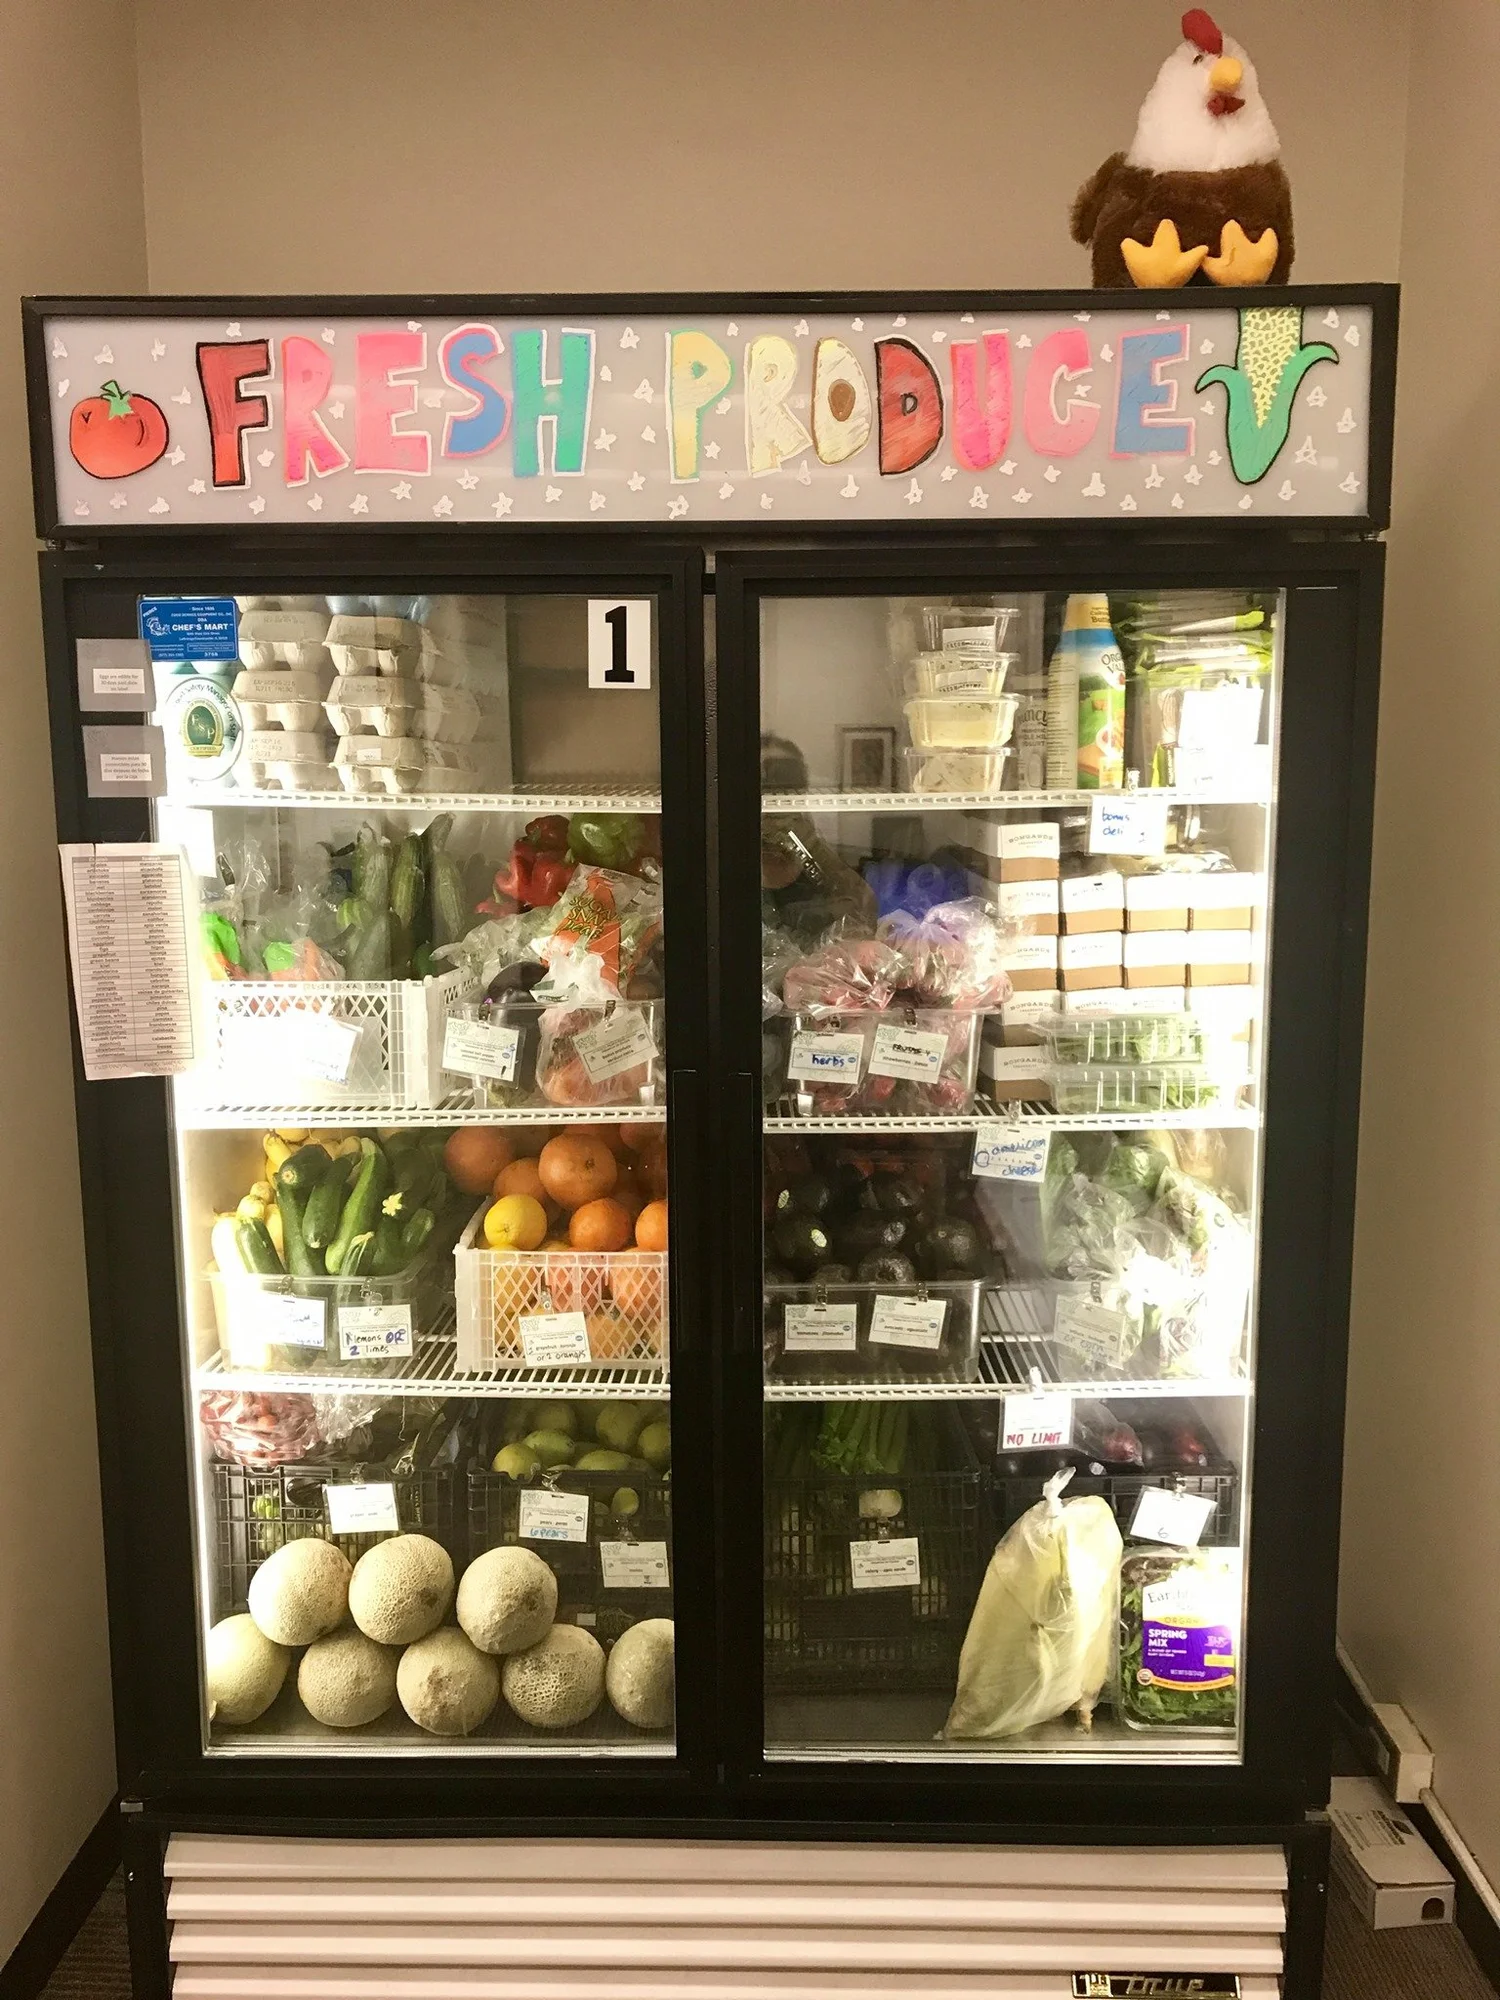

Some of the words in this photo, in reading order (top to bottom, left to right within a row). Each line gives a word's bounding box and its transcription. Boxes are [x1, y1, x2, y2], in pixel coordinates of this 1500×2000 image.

[196, 323, 596, 489] FRESH
[665, 324, 1196, 484] PRODUCE
[171, 623, 201, 631] CHEF'S
[605, 606, 634, 682] 1
[1103, 826, 1124, 836] deli
[812, 1054, 845, 1067] herbs
[354, 1335, 382, 1343] lemons
[386, 1328, 406, 1344] OR
[350, 1345, 360, 1356] 2
[366, 1345, 390, 1354] limes
[1006, 1433, 1024, 1446] NO
[1031, 1431, 1063, 1445] LIMIT
[540, 1529, 569, 1539] pears
[1157, 1526, 1169, 1540] 6
[1148, 1628, 1188, 1640] SPRING
[1148, 1638, 1169, 1648] MIX
